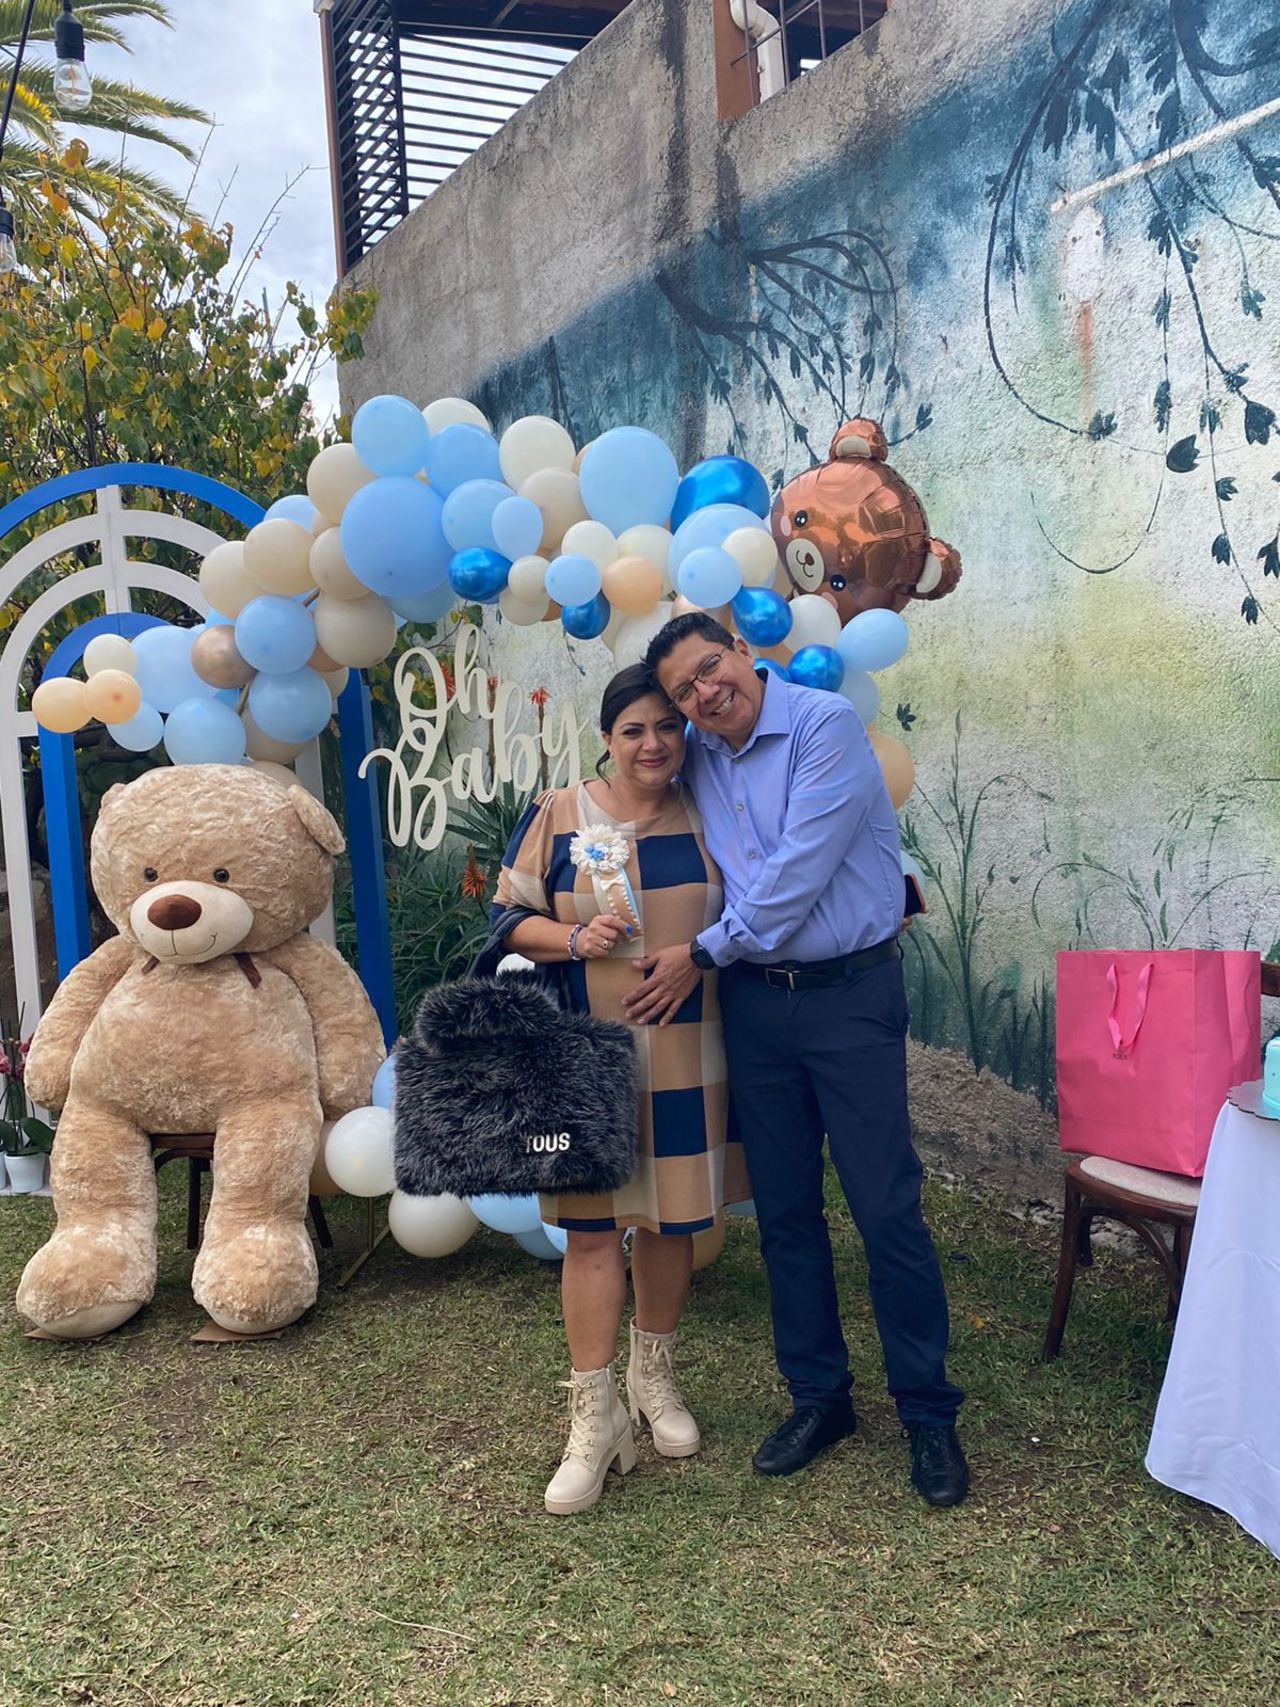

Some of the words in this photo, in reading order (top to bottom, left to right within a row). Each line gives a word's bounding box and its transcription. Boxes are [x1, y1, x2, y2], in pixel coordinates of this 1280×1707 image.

[394, 623, 498, 752] Oh
[358, 680, 590, 850] Baby
[526, 1132, 570, 1153] TOUS
